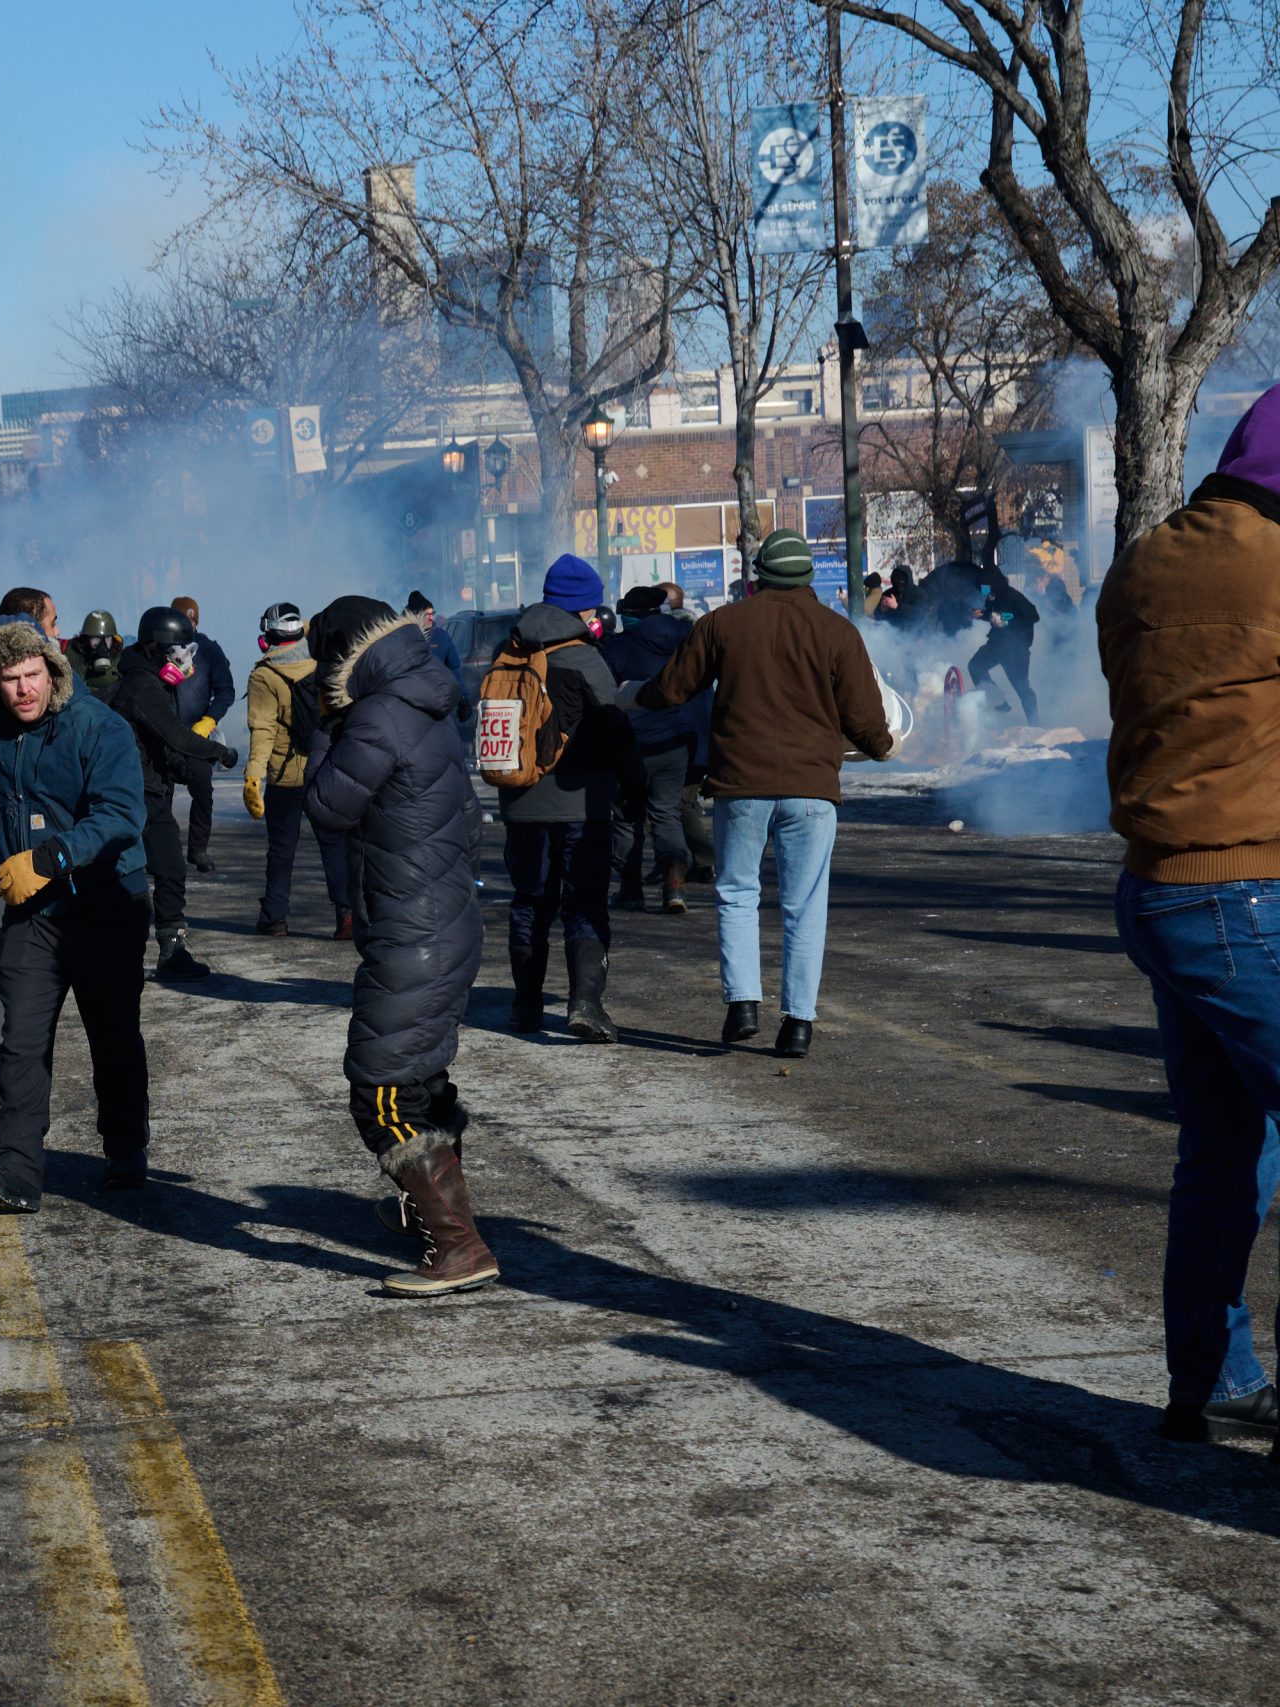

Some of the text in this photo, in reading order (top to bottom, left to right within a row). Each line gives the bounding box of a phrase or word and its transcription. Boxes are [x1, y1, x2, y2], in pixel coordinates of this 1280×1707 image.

[781, 199, 817, 213] street
[864, 193, 919, 206] eat street
[584, 530, 596, 555] &
[681, 560, 717, 570] Unlimited
[813, 560, 847, 570] Unlimited
[480, 719, 510, 737] ICE
[480, 739, 513, 758] OUT!
